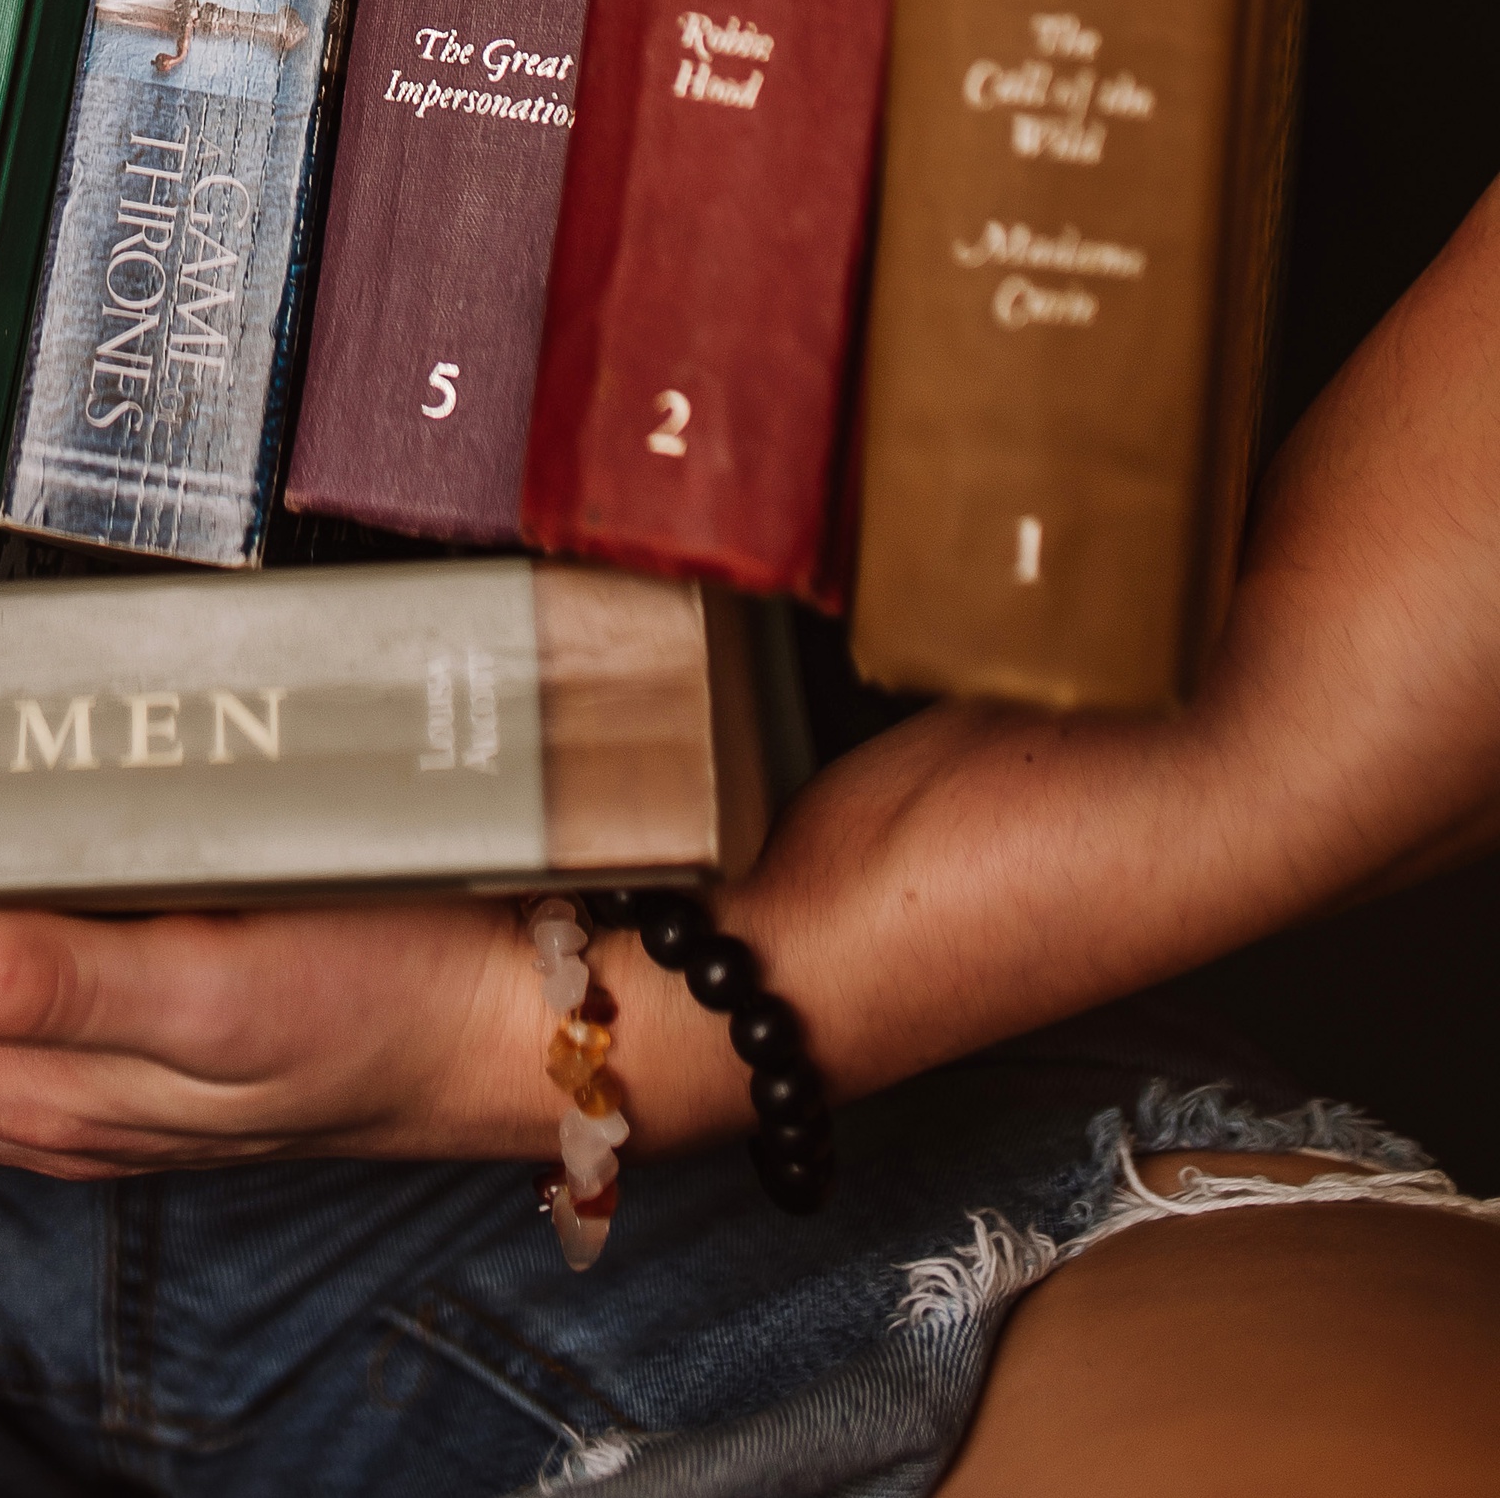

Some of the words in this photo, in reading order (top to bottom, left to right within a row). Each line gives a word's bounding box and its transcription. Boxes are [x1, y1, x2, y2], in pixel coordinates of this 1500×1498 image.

[414, 27, 474, 65] The
[481, 38, 575, 82] Great
[383, 69, 576, 129] Impersonatio
[85, 124, 191, 432] THRONES
[167, 174, 251, 386] GAME
[421, 361, 460, 420] 5
[647, 388, 691, 457] 2
